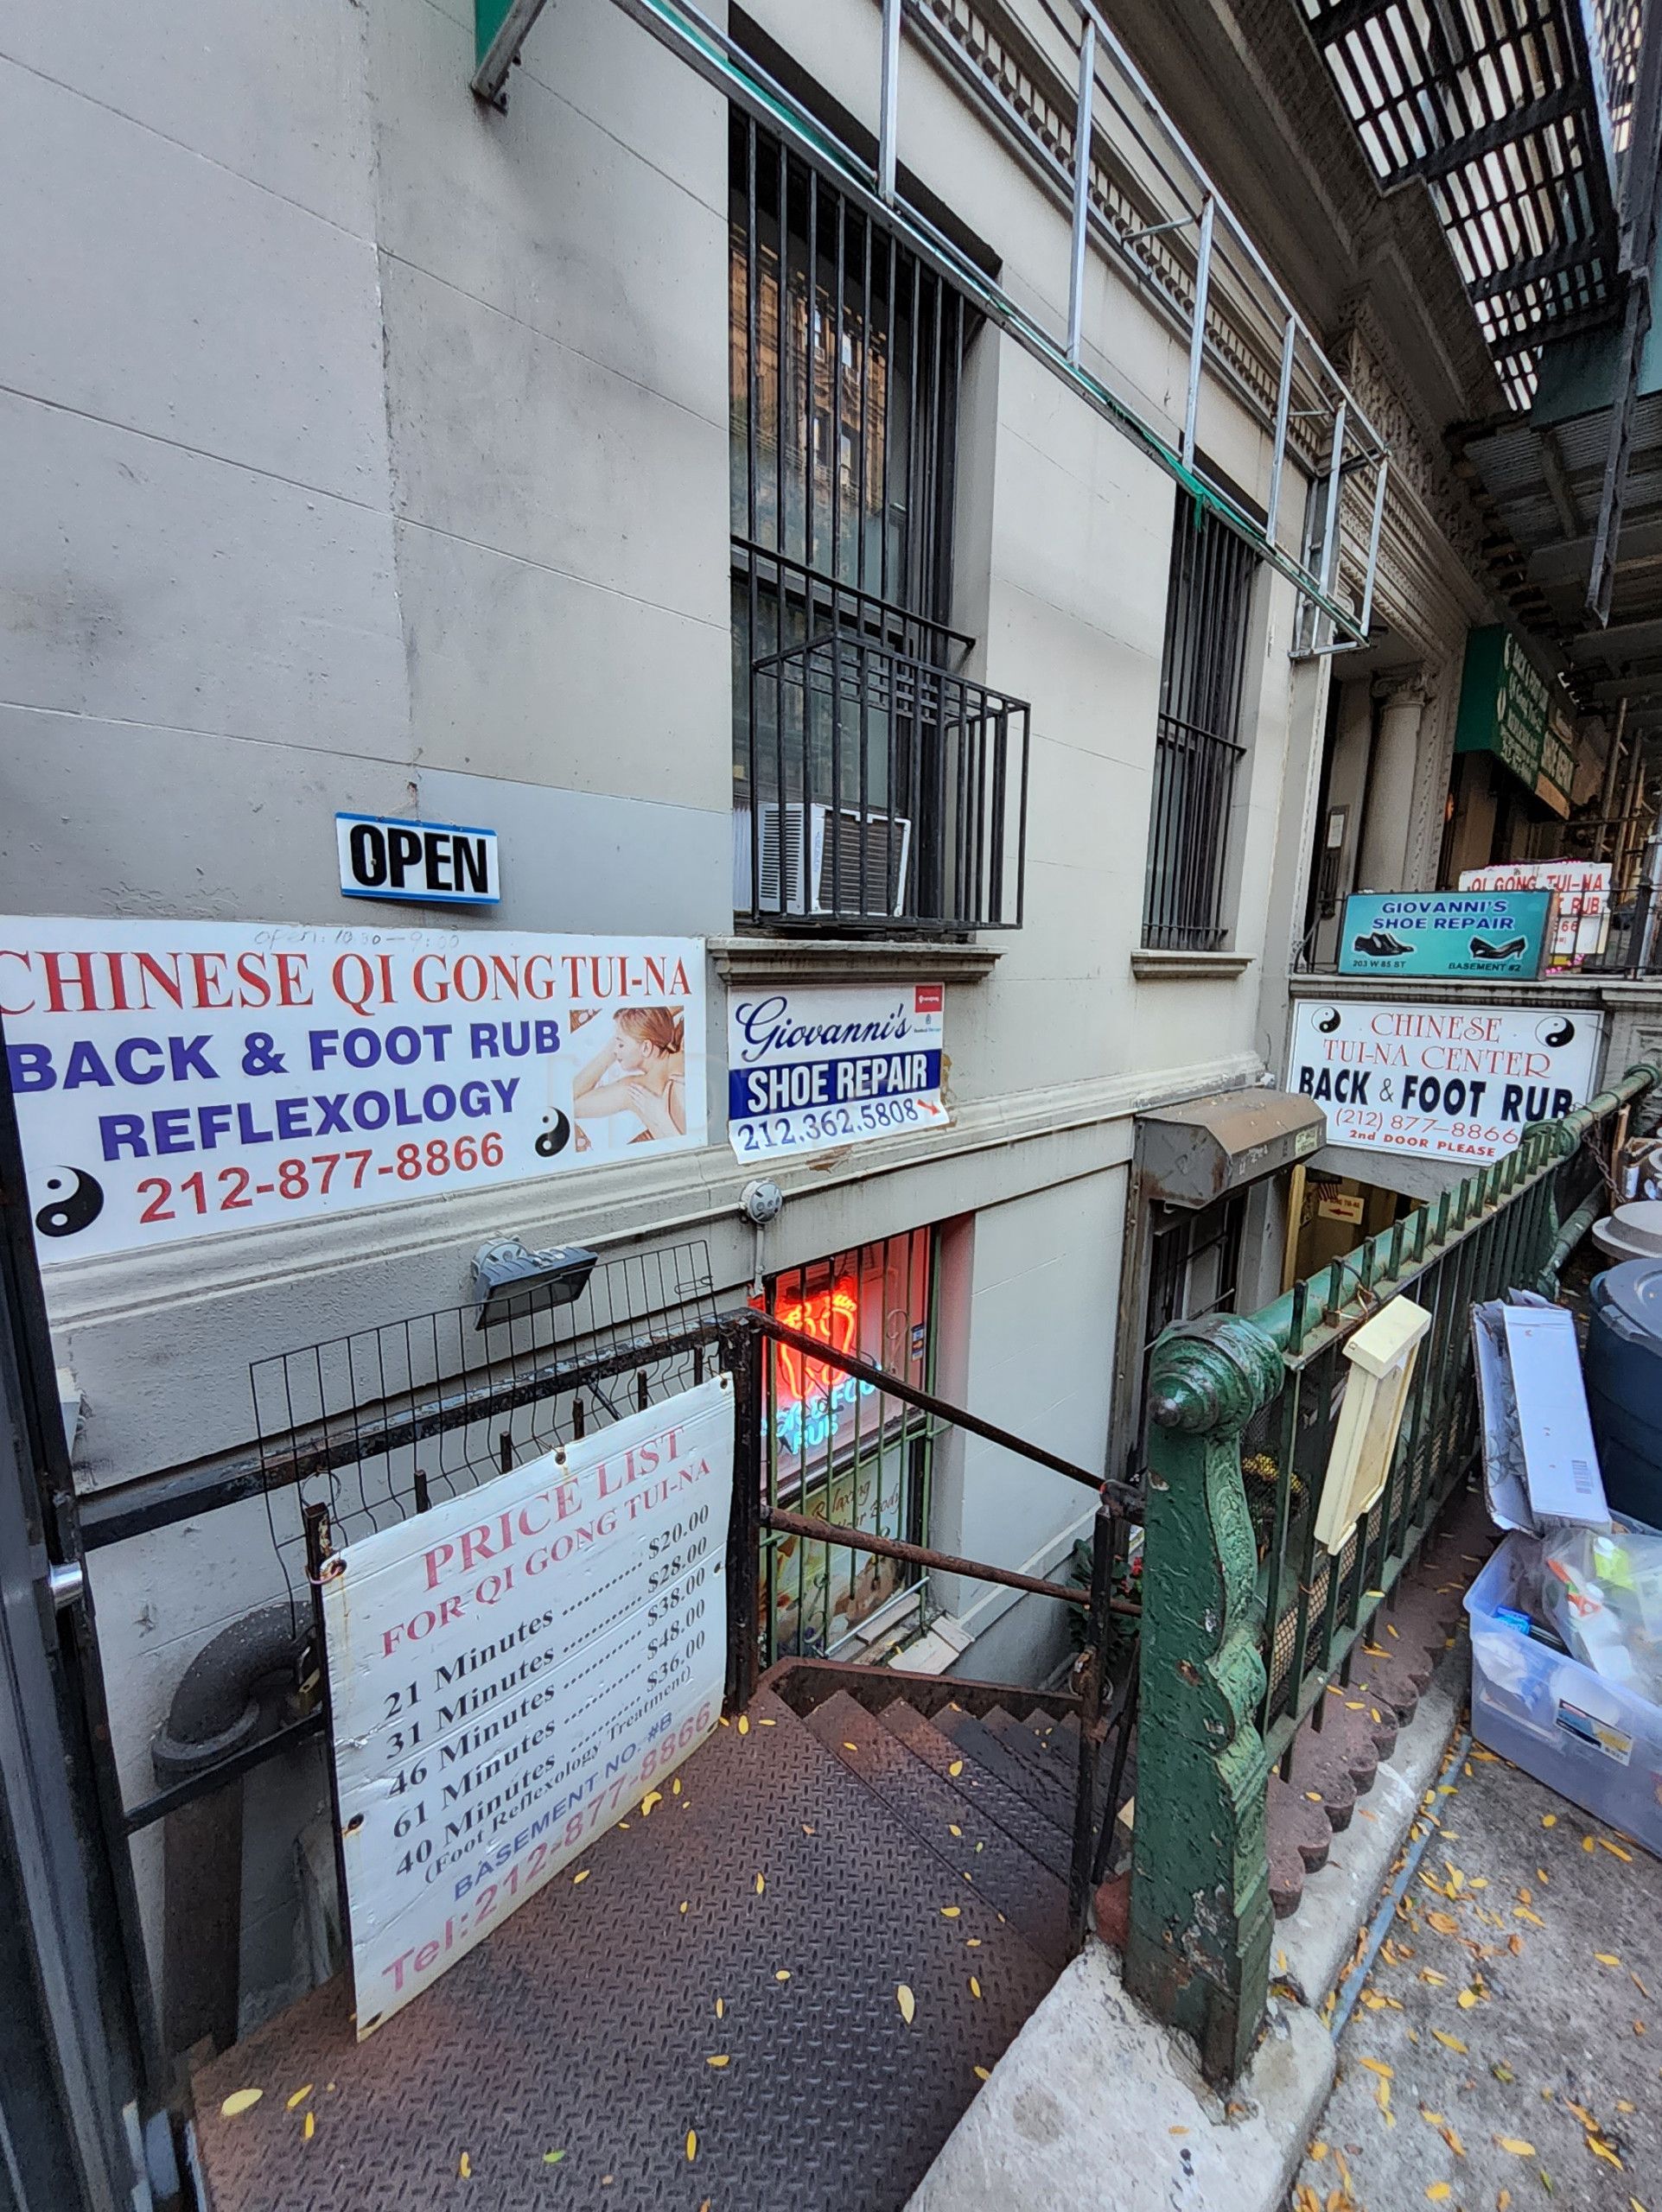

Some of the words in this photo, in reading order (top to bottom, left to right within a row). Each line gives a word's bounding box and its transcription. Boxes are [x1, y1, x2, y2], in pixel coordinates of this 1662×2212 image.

[350, 823, 488, 893] OPEN
[1494, 875, 1537, 891] GONG
[1546, 874, 1602, 892] TUI-NA
[1372, 918, 1427, 930] SHOE
[1434, 917, 1514, 930] REPAIR
[1382, 901, 1507, 914] GIOVANNI'S
[1571, 897, 1600, 914] RUB
[0, 950, 314, 1015] CHINESE
[332, 952, 398, 1016] QI
[412, 953, 556, 1003] GONG
[561, 956, 692, 998] TUI-NA
[1449, 963, 1506, 972] BASEMENT
[6, 1034, 220, 1093] BACK
[241, 1031, 290, 1077] &
[309, 1024, 453, 1071] FOOT
[469, 1020, 561, 1059] RUB
[735, 995, 913, 1063] Giovanni's
[1323, 1039, 1410, 1067] TUI-NA
[1421, 1046, 1551, 1078] CENTER
[1371, 1013, 1502, 1044] CHINESE
[748, 1064, 829, 1114] SHOE
[837, 1053, 927, 1101] REPAIR
[1299, 1065, 1372, 1105] BACK
[1379, 1077, 1394, 1103] &
[1401, 1074, 1487, 1118] FOOT
[1500, 1084, 1573, 1122] RUB
[99, 1077, 520, 1162] REFLEXOLOGY
[738, 1097, 919, 1152] 212.362.5808
[1335, 1108, 1384, 1132] (212)
[1391, 1115, 1519, 1144] 877-8866
[1349, 1129, 1376, 1141] 2nd
[1384, 1133, 1429, 1148] DOOR
[1436, 1141, 1496, 1157] PLEASE
[137, 1131, 505, 1224] 212-877-8866
[421, 1477, 583, 1592] PRICE
[596, 1426, 685, 1501] LIST
[380, 1594, 466, 1659] FOR
[475, 1563, 517, 1605] QI
[525, 1509, 617, 1577] GONG
[624, 1458, 710, 1522] TUI-NA
[384, 1681, 422, 1721] 21
[434, 1609, 554, 1694] Minutes
[648, 1504, 710, 1560] $20.00
[386, 1721, 423, 1760] 31
[436, 1646, 554, 1732] Minutes
[647, 1536, 707, 1594] $28.00
[389, 1757, 428, 1799] 46
[437, 1684, 555, 1770] Minutes
[647, 1567, 705, 1627] $38.00
[393, 1801, 429, 1839] 61
[441, 1719, 556, 1812] Minutes
[647, 1599, 705, 1662] $48.00
[395, 1839, 432, 1877] 40
[443, 1754, 556, 1848] Minutes
[646, 1630, 705, 1694] $36.00
[424, 1831, 484, 1885] (Foot
[492, 1740, 603, 1834] Reflexology
[607, 1666, 692, 1744] Treatment)
[455, 1771, 599, 1902] BASEMENT
[605, 1741, 641, 1779] NO.
[646, 1712, 673, 1744] #B
